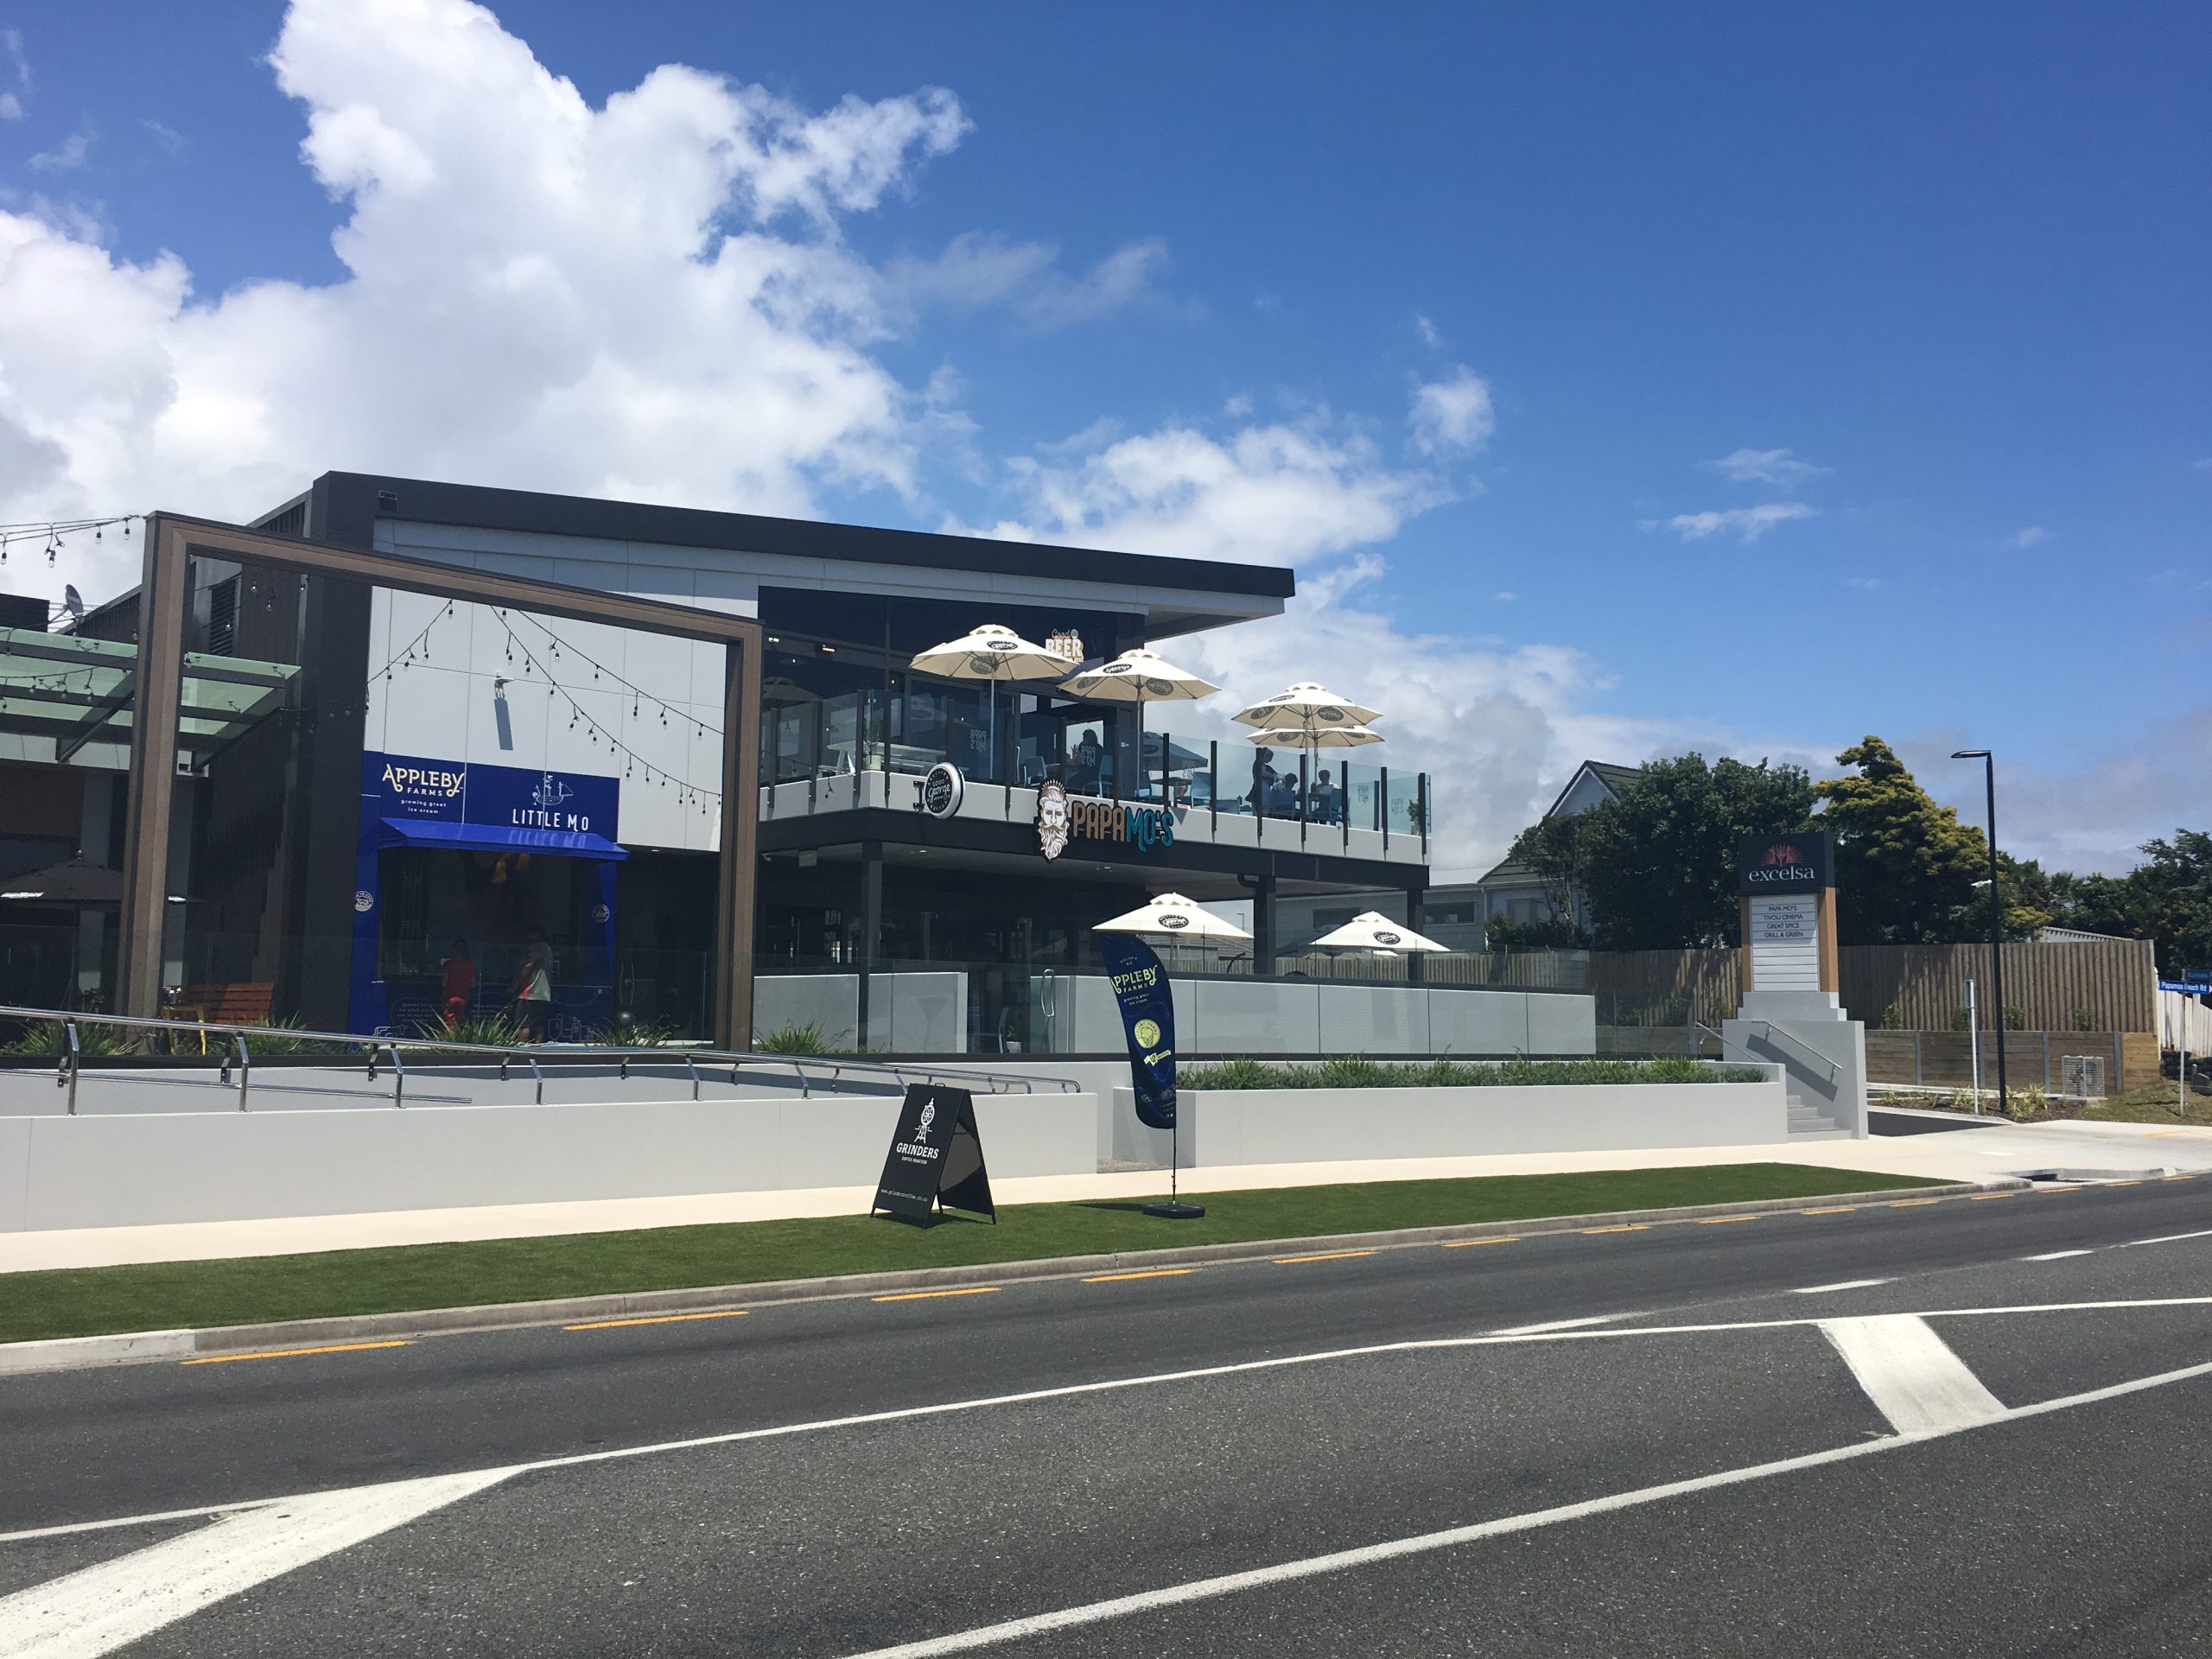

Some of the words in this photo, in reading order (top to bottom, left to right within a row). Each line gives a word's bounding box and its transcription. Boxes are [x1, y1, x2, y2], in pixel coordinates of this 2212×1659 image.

[1046, 639, 1084, 658] BEER
[382, 764, 465, 798] APPLEBY
[407, 787, 443, 797] FARMS
[928, 784, 950, 803] George
[512, 808, 562, 828] LITTLE
[567, 814, 589, 832] MO
[1748, 866, 1815, 882] excelsa
[2161, 981, 2183, 990] Papamoa
[2183, 982, 2199, 992] Beach
[2199, 984, 2207, 993] Rd
[897, 1142, 939, 1159] GRINDERS
